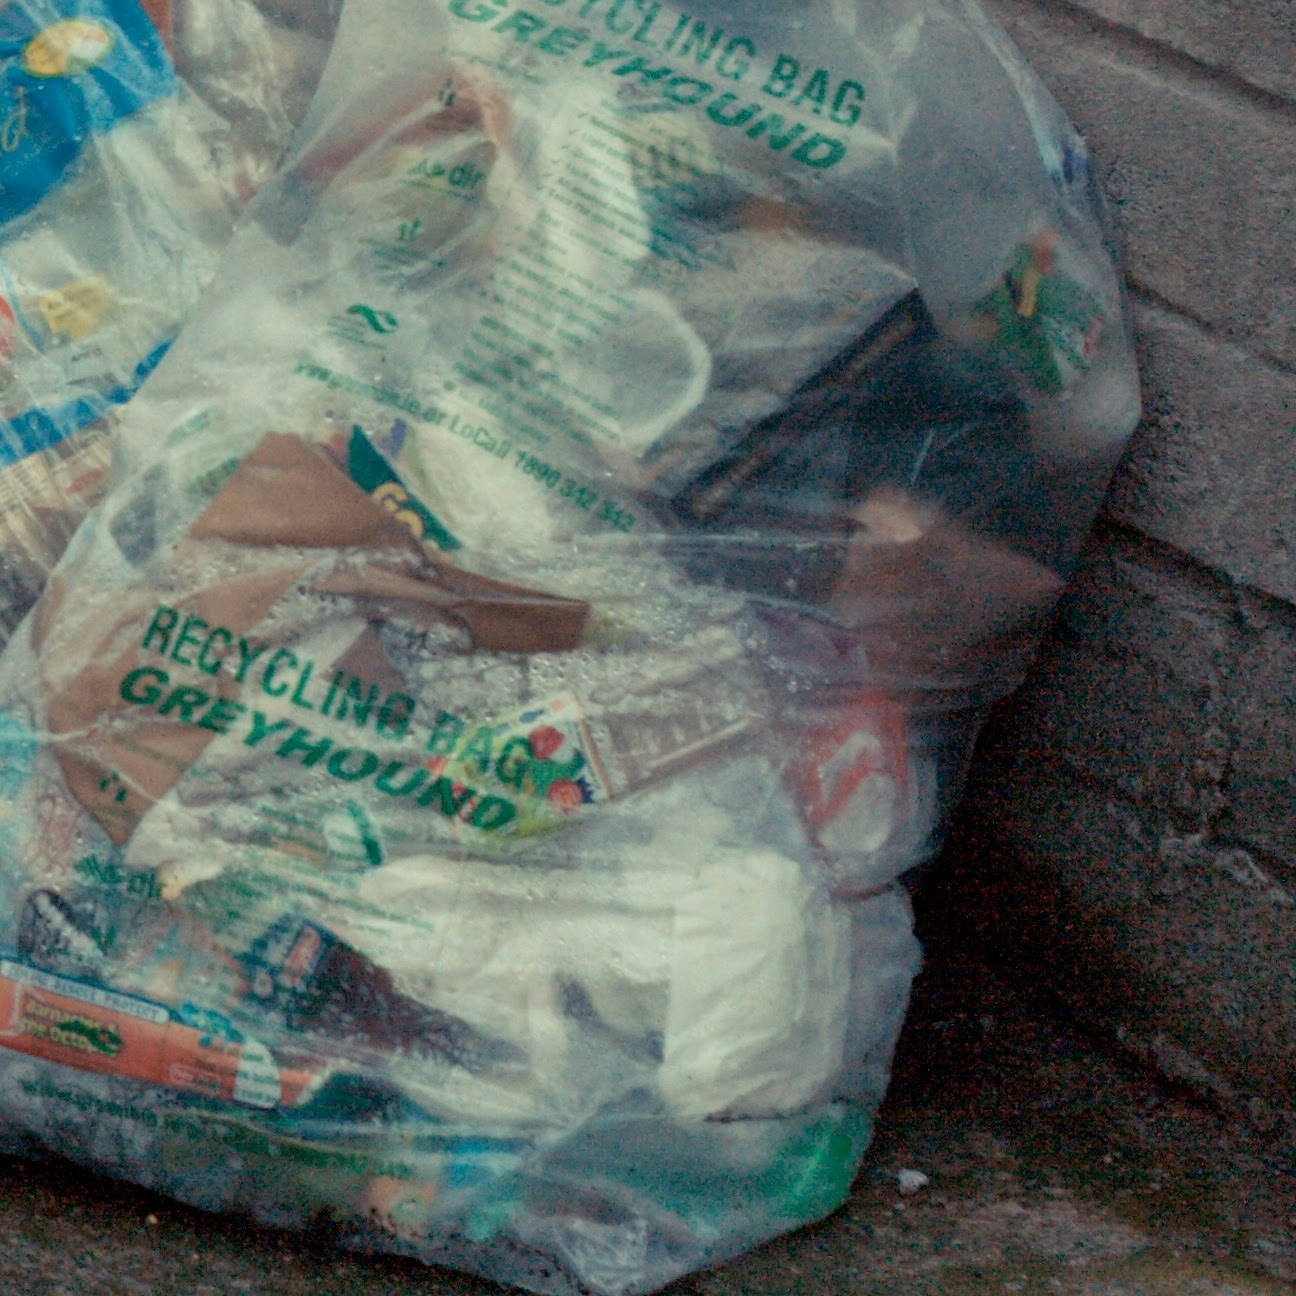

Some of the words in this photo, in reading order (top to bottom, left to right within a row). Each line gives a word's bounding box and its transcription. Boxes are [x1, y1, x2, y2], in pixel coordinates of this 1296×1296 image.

[761, 52, 867, 128] BAG
[448, 414, 513, 461] LoCall
[118, 666, 518, 831] GREYHOUND
[141, 604, 418, 742] RECYCLING
[425, 710, 537, 789] BAG
